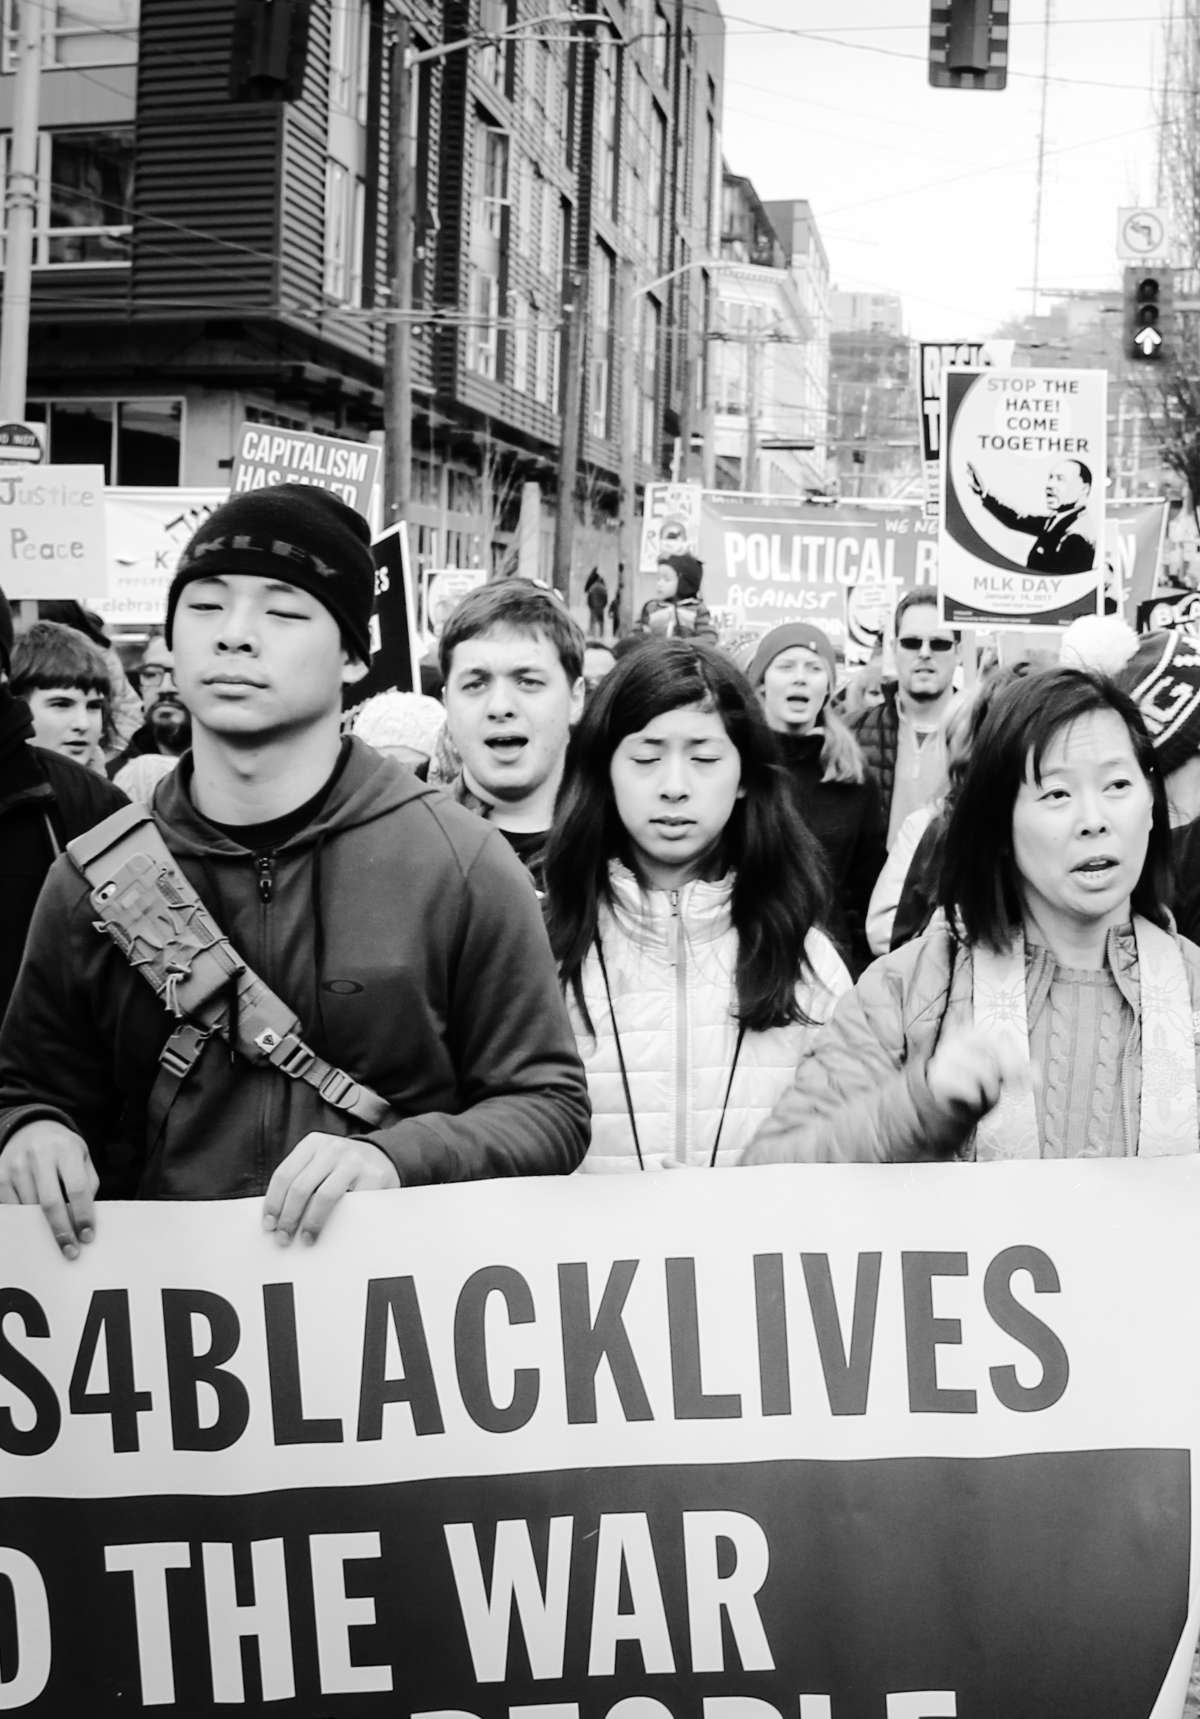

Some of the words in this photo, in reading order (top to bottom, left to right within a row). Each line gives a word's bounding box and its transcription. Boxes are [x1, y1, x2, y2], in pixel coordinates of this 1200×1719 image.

[987, 378, 1036, 392] STOP
[1043, 380, 1080, 394] THE
[1006, 398, 1060, 413] HATE!
[1007, 417, 1059, 431] COME
[242, 431, 368, 482] CAPITALISM
[978, 434, 1089, 453] TOGETHER
[0, 476, 94, 507] Justice
[885, 518, 909, 533] WE
[10, 527, 85, 560] Peace
[723, 530, 904, 586] POLITICAL
[727, 583, 838, 611] AGAINST
[973, 576, 1014, 591] MLK
[1022, 578, 1063, 593] DAY
[0, 1244, 1070, 1456] S4BLACKLIVES
[104, 1530, 393, 1706] THE
[443, 1510, 776, 1684] WAR
